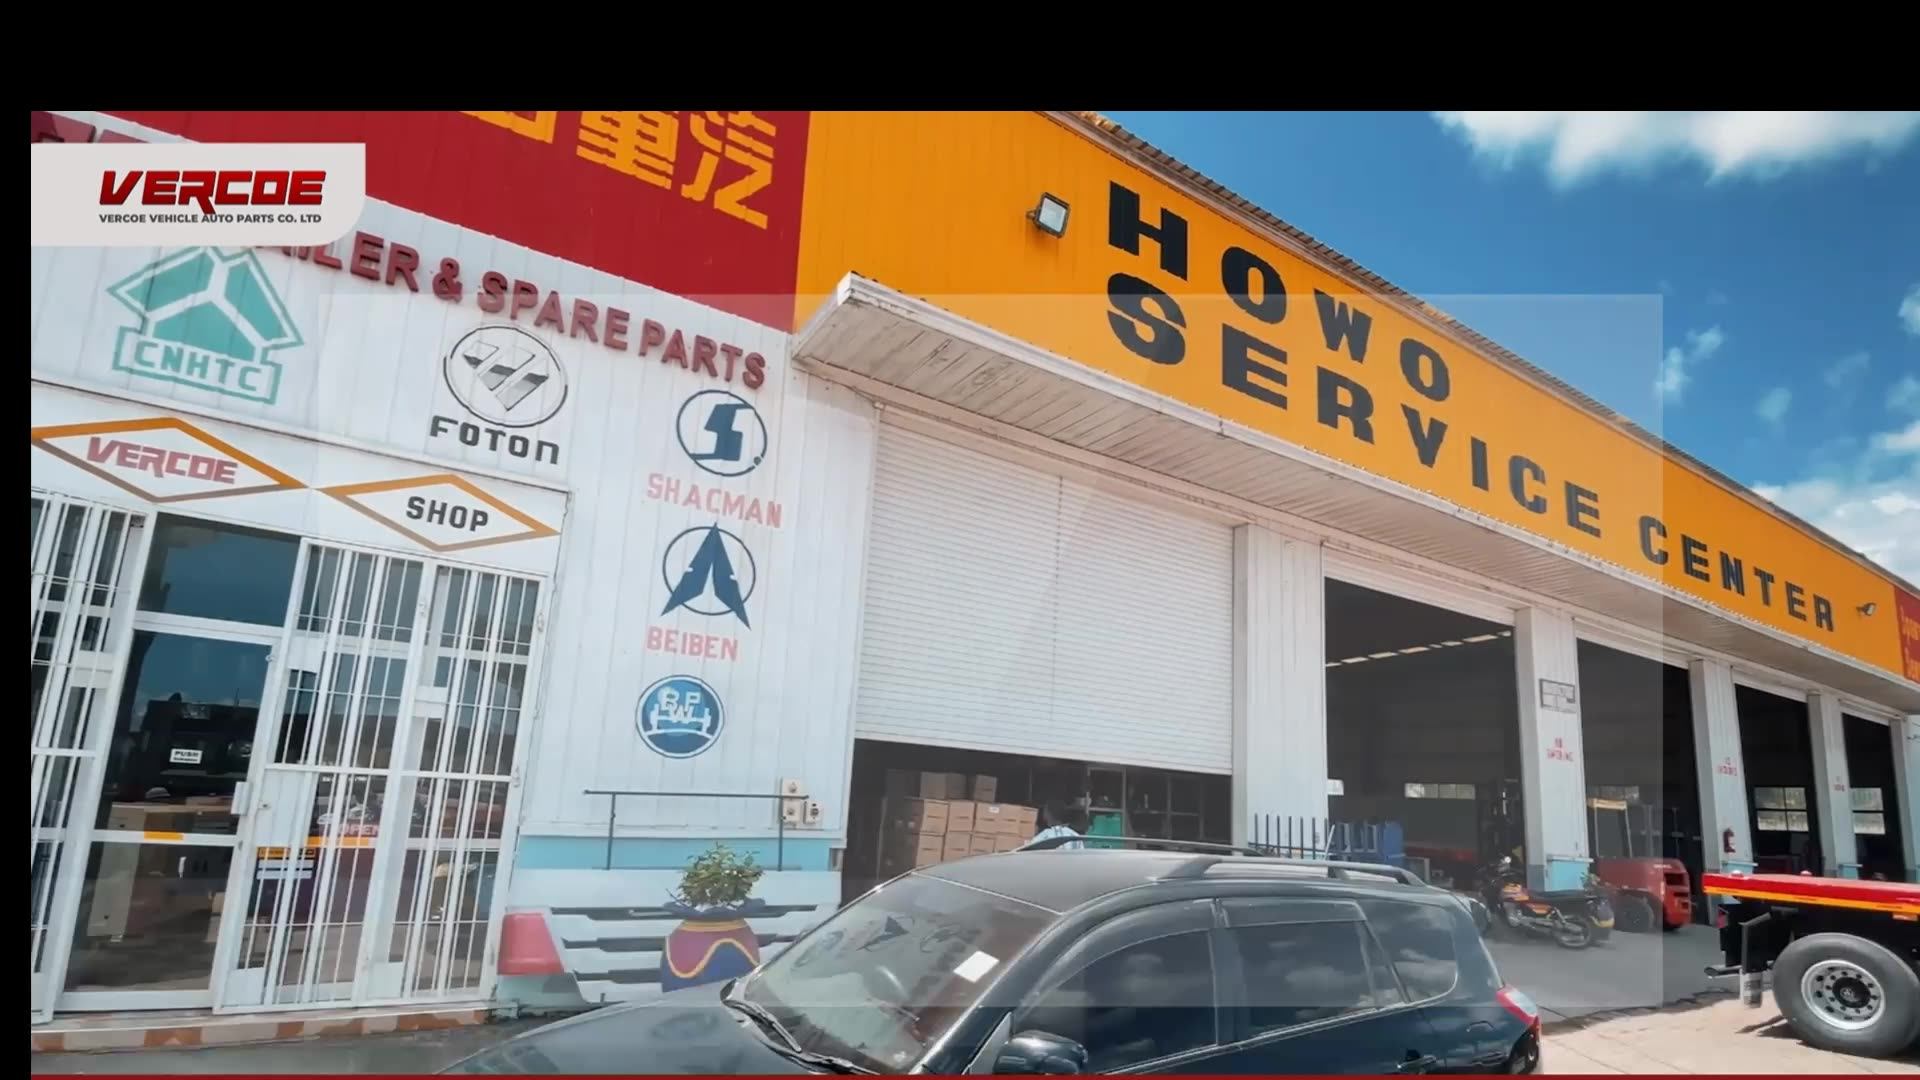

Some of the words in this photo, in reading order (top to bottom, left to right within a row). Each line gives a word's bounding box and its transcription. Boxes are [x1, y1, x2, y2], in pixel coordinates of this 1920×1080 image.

[1108, 180, 1450, 402] HOWO
[432, 257, 463, 303] &
[478, 271, 630, 351] SPARE
[638, 318, 766, 389] PARTS
[134, 342, 262, 391] CNHTC
[88, 436, 238, 485] VERCOE
[430, 415, 560, 465] FOTON
[1107, 273, 1601, 538] SERVICE
[1639, 516, 1834, 632] CENTER
[406, 495, 489, 532] SHOP
[647, 472, 782, 528] SHACMAN
[646, 626, 739, 661] BEIBEN
